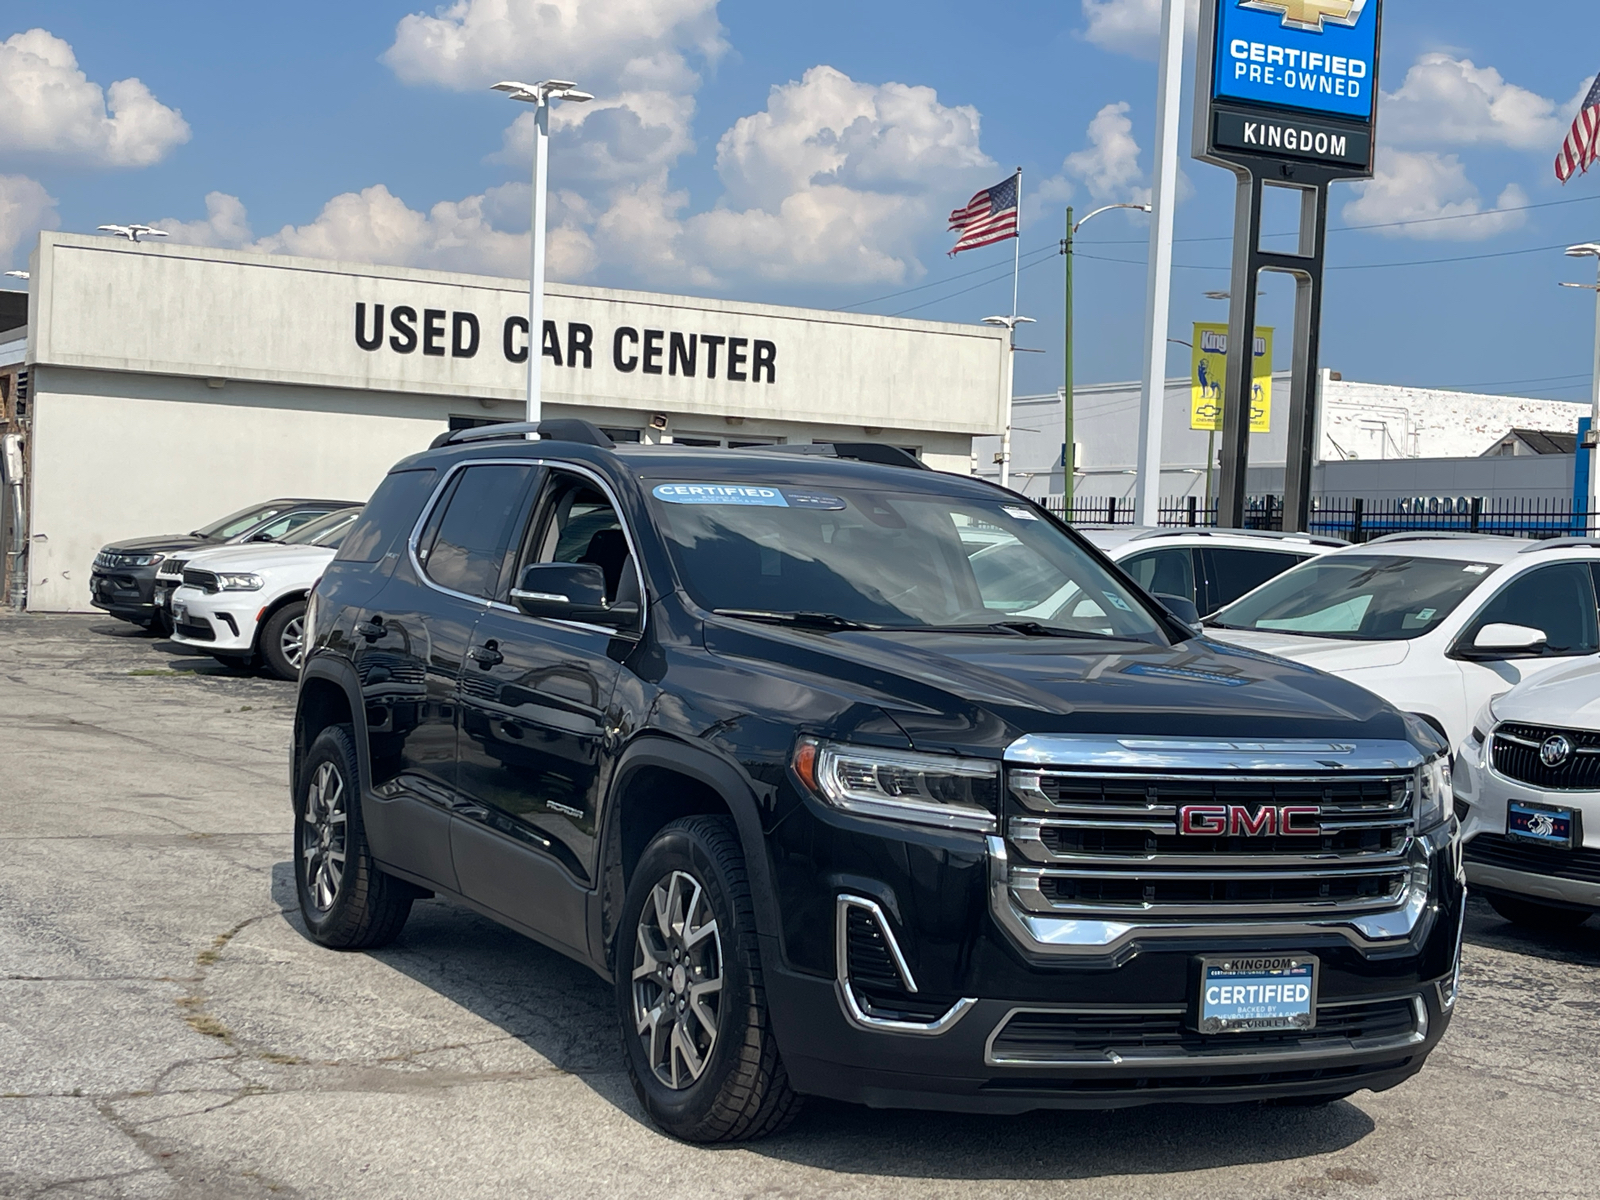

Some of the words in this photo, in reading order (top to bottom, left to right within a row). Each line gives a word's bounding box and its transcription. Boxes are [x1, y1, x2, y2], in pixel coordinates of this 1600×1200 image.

[1230, 39, 1367, 78] CERTIFIED
[1234, 62, 1360, 98] PRE-OWNED
[1243, 121, 1347, 156] KINGDOM
[354, 302, 480, 358] USED
[503, 315, 594, 369] CAR
[613, 326, 777, 383] CENTER
[658, 486, 775, 498] CERTIFIED
[1397, 496, 1484, 513] KINGDO
[1179, 804, 1321, 836] GMC
[1231, 958, 1291, 970] KINGDOM
[1206, 984, 1309, 1005] CERTIFIED
